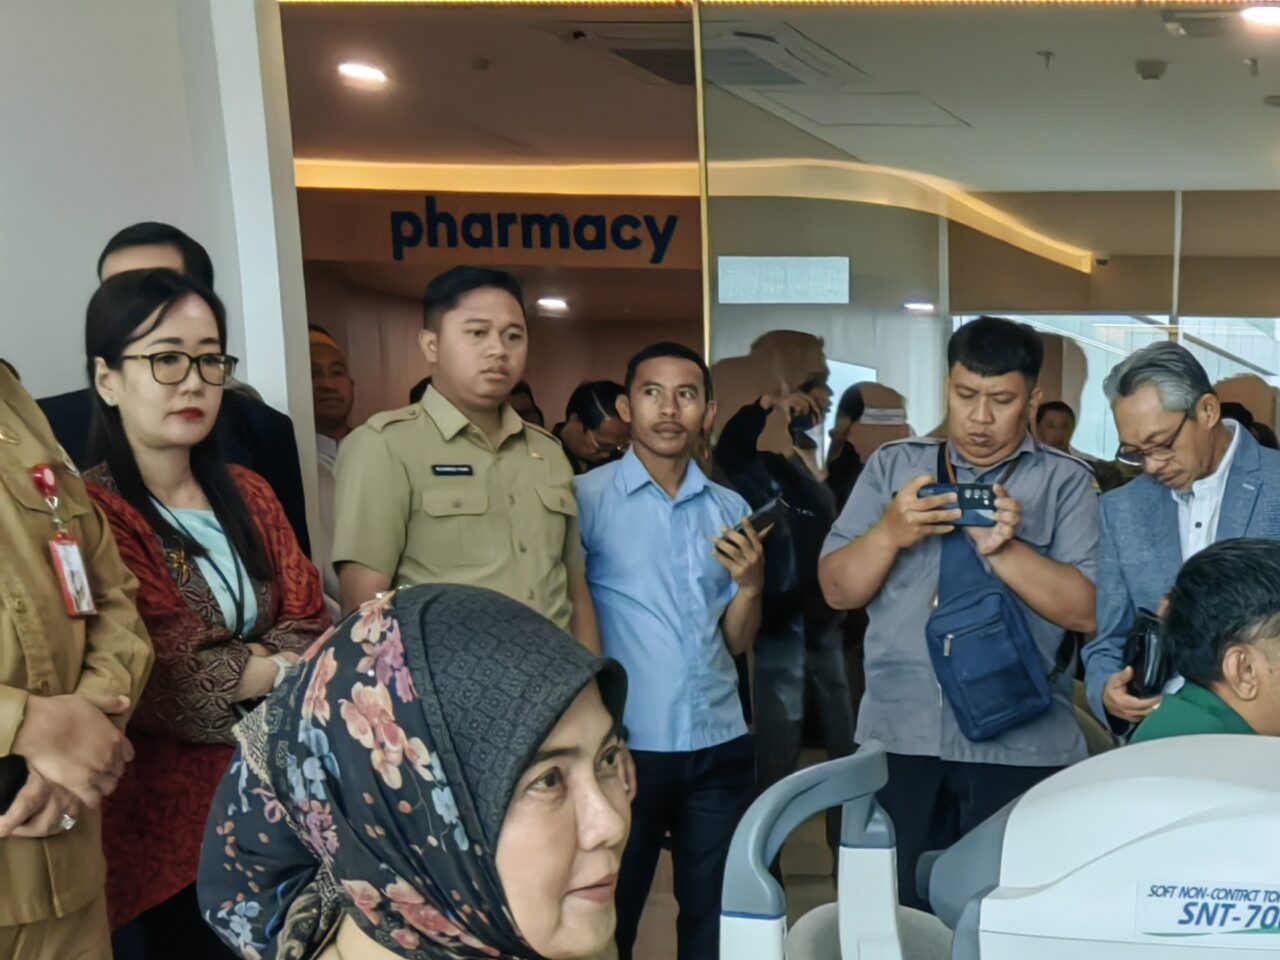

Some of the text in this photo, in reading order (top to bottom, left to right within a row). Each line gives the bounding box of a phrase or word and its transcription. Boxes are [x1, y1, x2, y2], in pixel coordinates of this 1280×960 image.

[391, 196, 678, 263] pharmacy
[1148, 885, 1177, 898] SOFT
[1179, 886, 1260, 902] NON-CONTACT
